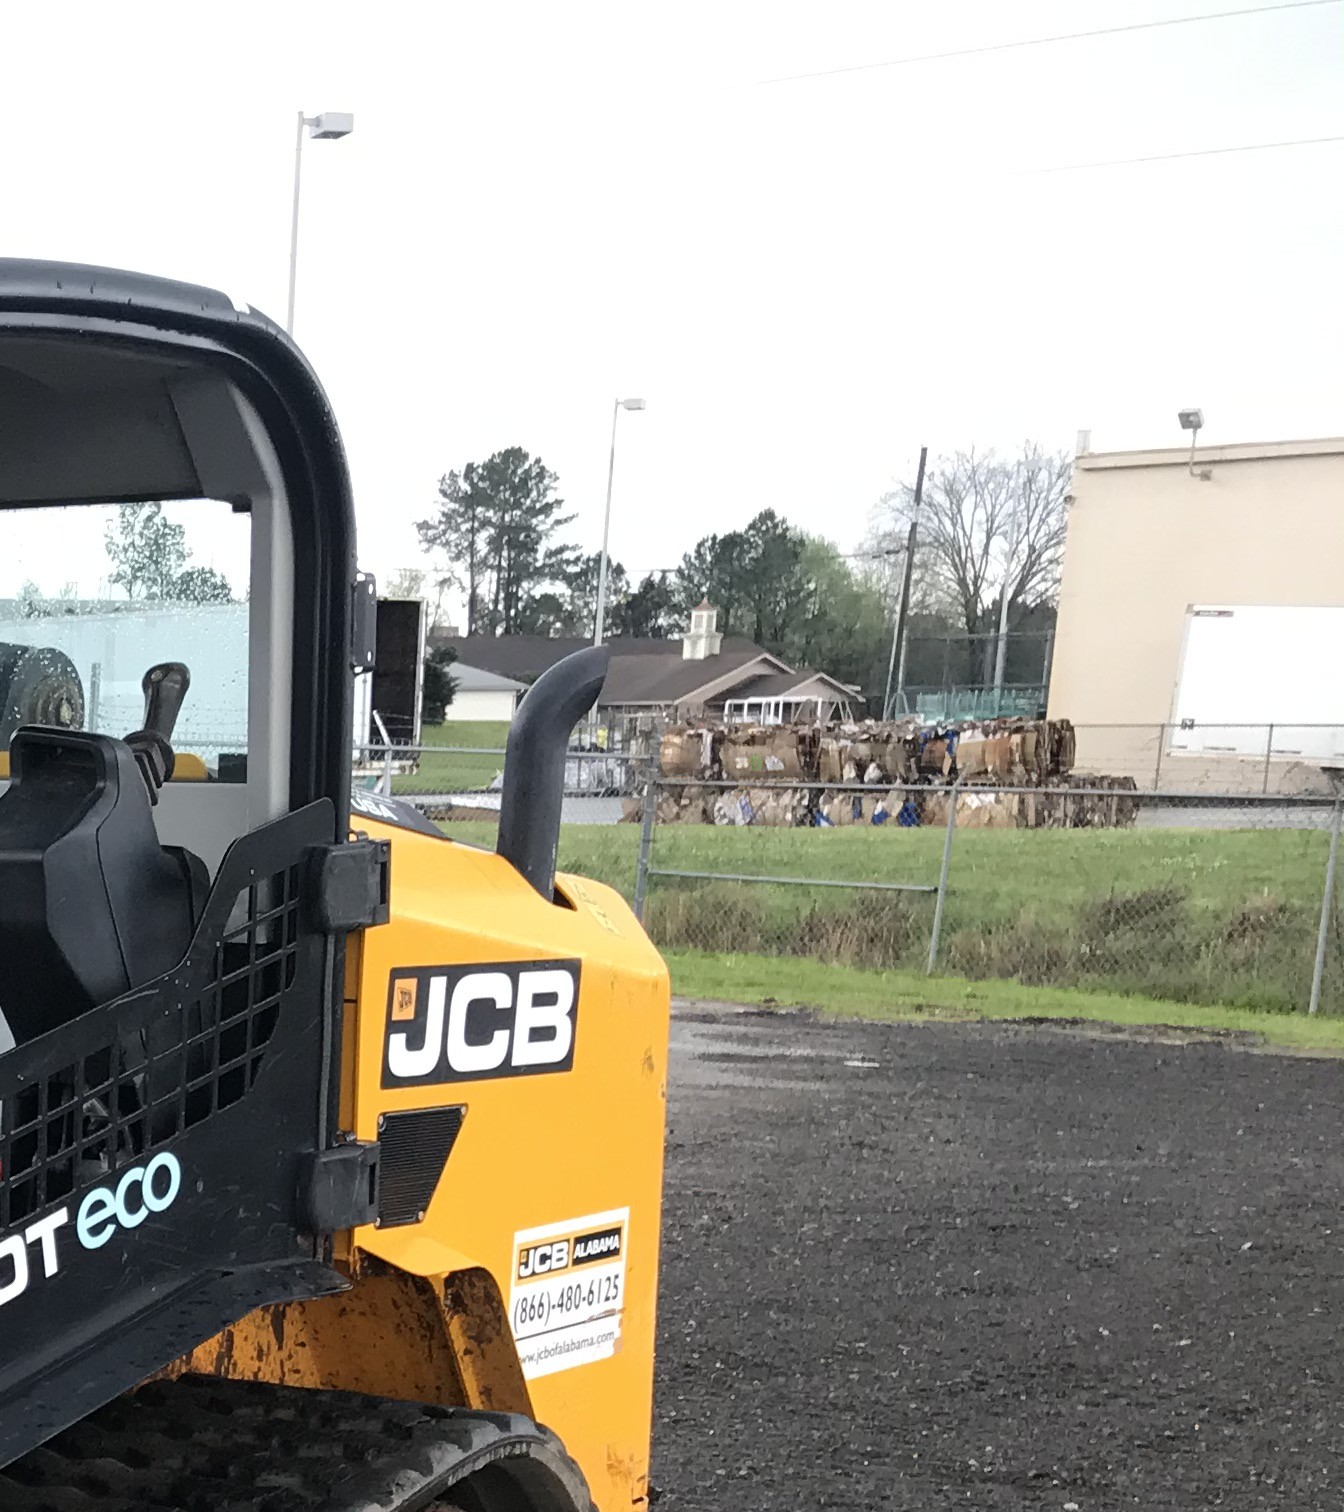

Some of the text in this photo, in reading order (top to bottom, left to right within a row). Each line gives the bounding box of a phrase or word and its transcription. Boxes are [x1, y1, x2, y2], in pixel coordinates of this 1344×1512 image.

[388, 969, 575, 1078] JCB
[76, 1152, 182, 1250] eco
[519, 1234, 620, 1277] JCB ALABAMA
[513, 1273, 620, 1335] (866)-480-6125
